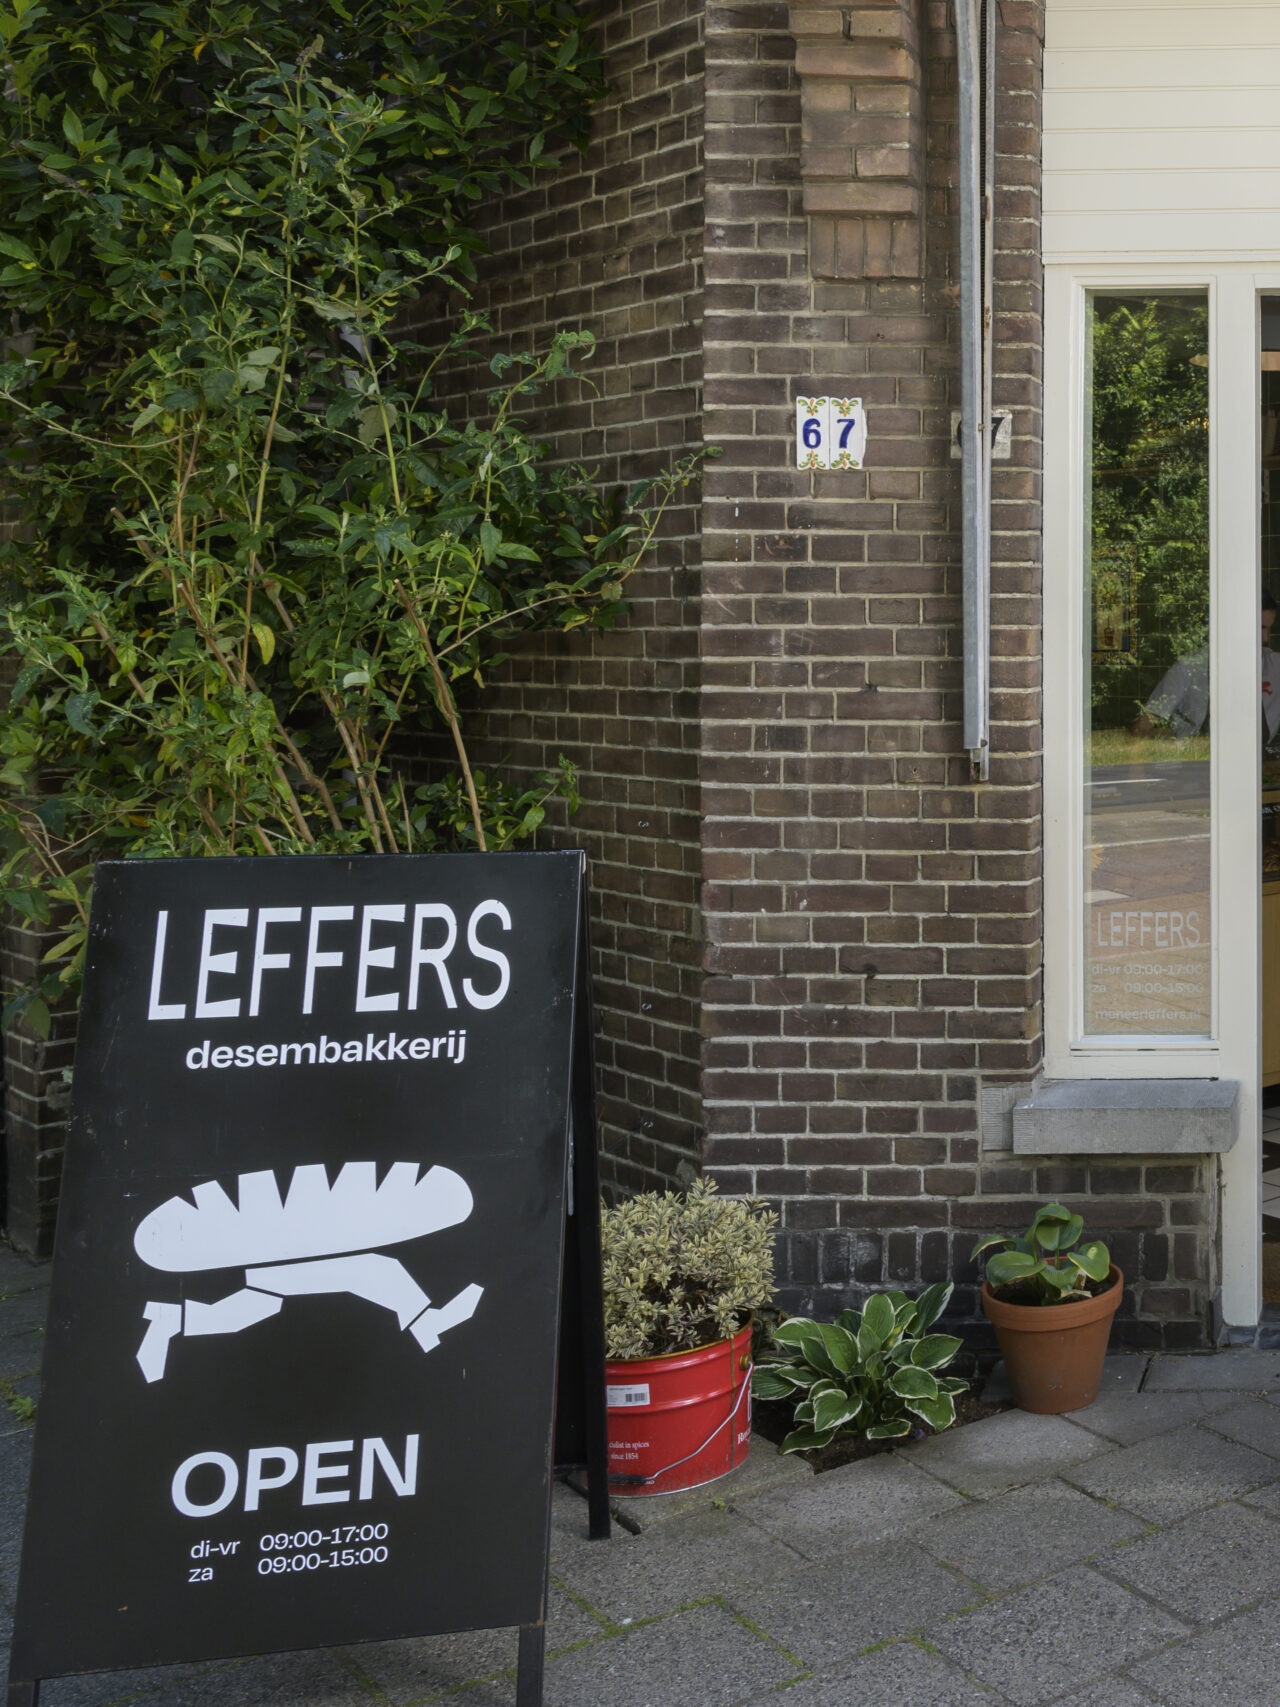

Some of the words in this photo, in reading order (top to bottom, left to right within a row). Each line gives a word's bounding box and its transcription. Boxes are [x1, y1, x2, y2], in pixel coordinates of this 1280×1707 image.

[802, 418, 856, 449] 67
[957, 416, 1005, 450] 7
[1097, 911, 1200, 948] LEFFERS
[148, 899, 512, 1021] LEFFERS
[1091, 984, 1107, 993] za
[185, 1030, 467, 1070] desembakkerij
[608, 1440, 624, 1449] cialist
[171, 1433, 420, 1518] OPEN
[190, 1538, 241, 1559] di-vr
[259, 1523, 390, 1552] 09:00-17:00
[187, 1566, 214, 1583] za
[257, 1546, 389, 1575] 09:00-15:00
